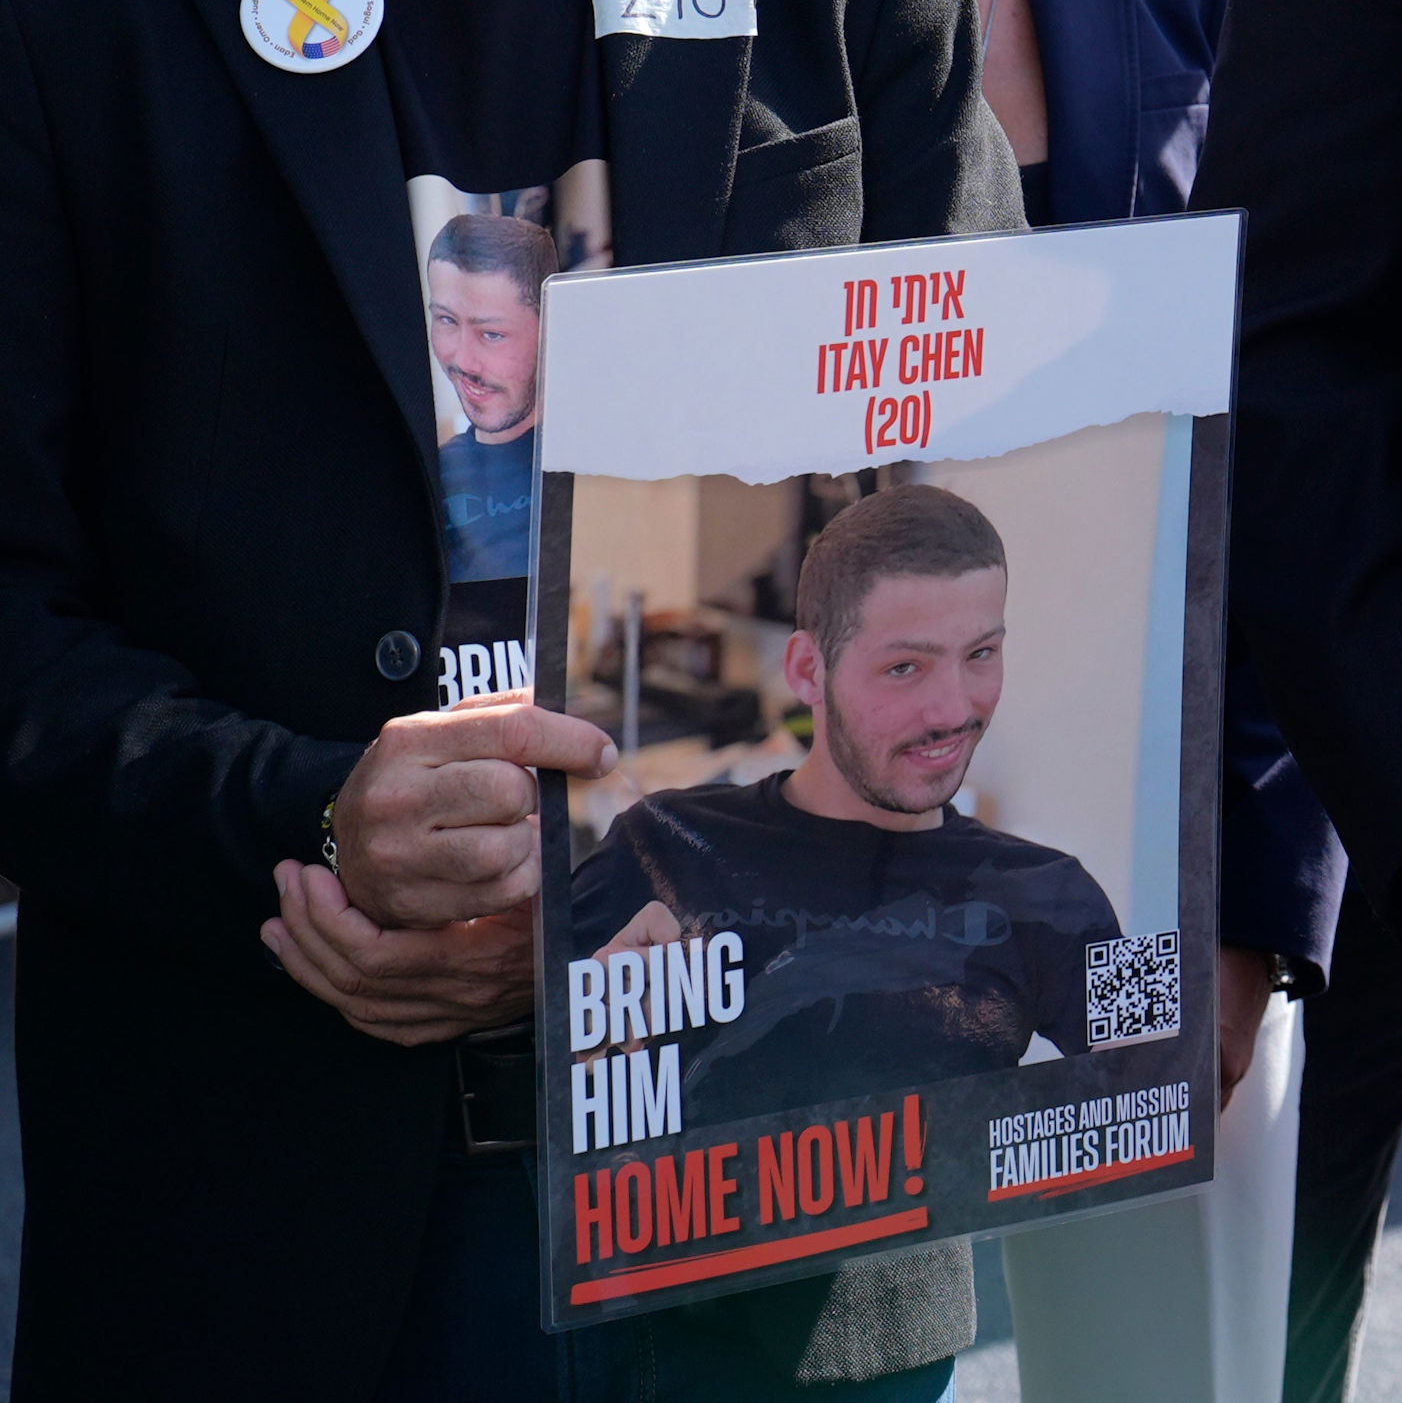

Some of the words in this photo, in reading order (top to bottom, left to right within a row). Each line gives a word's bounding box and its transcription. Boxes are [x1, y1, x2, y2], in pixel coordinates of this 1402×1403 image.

[255, 22, 270, 43] Omer
[312, 5, 331, 22] Home
[347, 30, 364, 45] Gad
[274, 44, 296, 58] Edan
[844, 279, 878, 337] חן
[891, 270, 966, 325] איתי
[817, 338, 889, 394] ITAY
[898, 328, 984, 385] CHEN
[865, 390, 932, 455] (20)
[568, 930, 745, 1053] BRING
[570, 1043, 682, 1155] HIM
[989, 1104, 1076, 1148] HOSTAGES
[1079, 1097, 1112, 1130] AND
[1116, 1081, 1190, 1123] MISSING
[990, 1129, 1100, 1191] FAMILIES
[1105, 1110, 1190, 1168] FORUM
[574, 1142, 740, 1265] HOME
